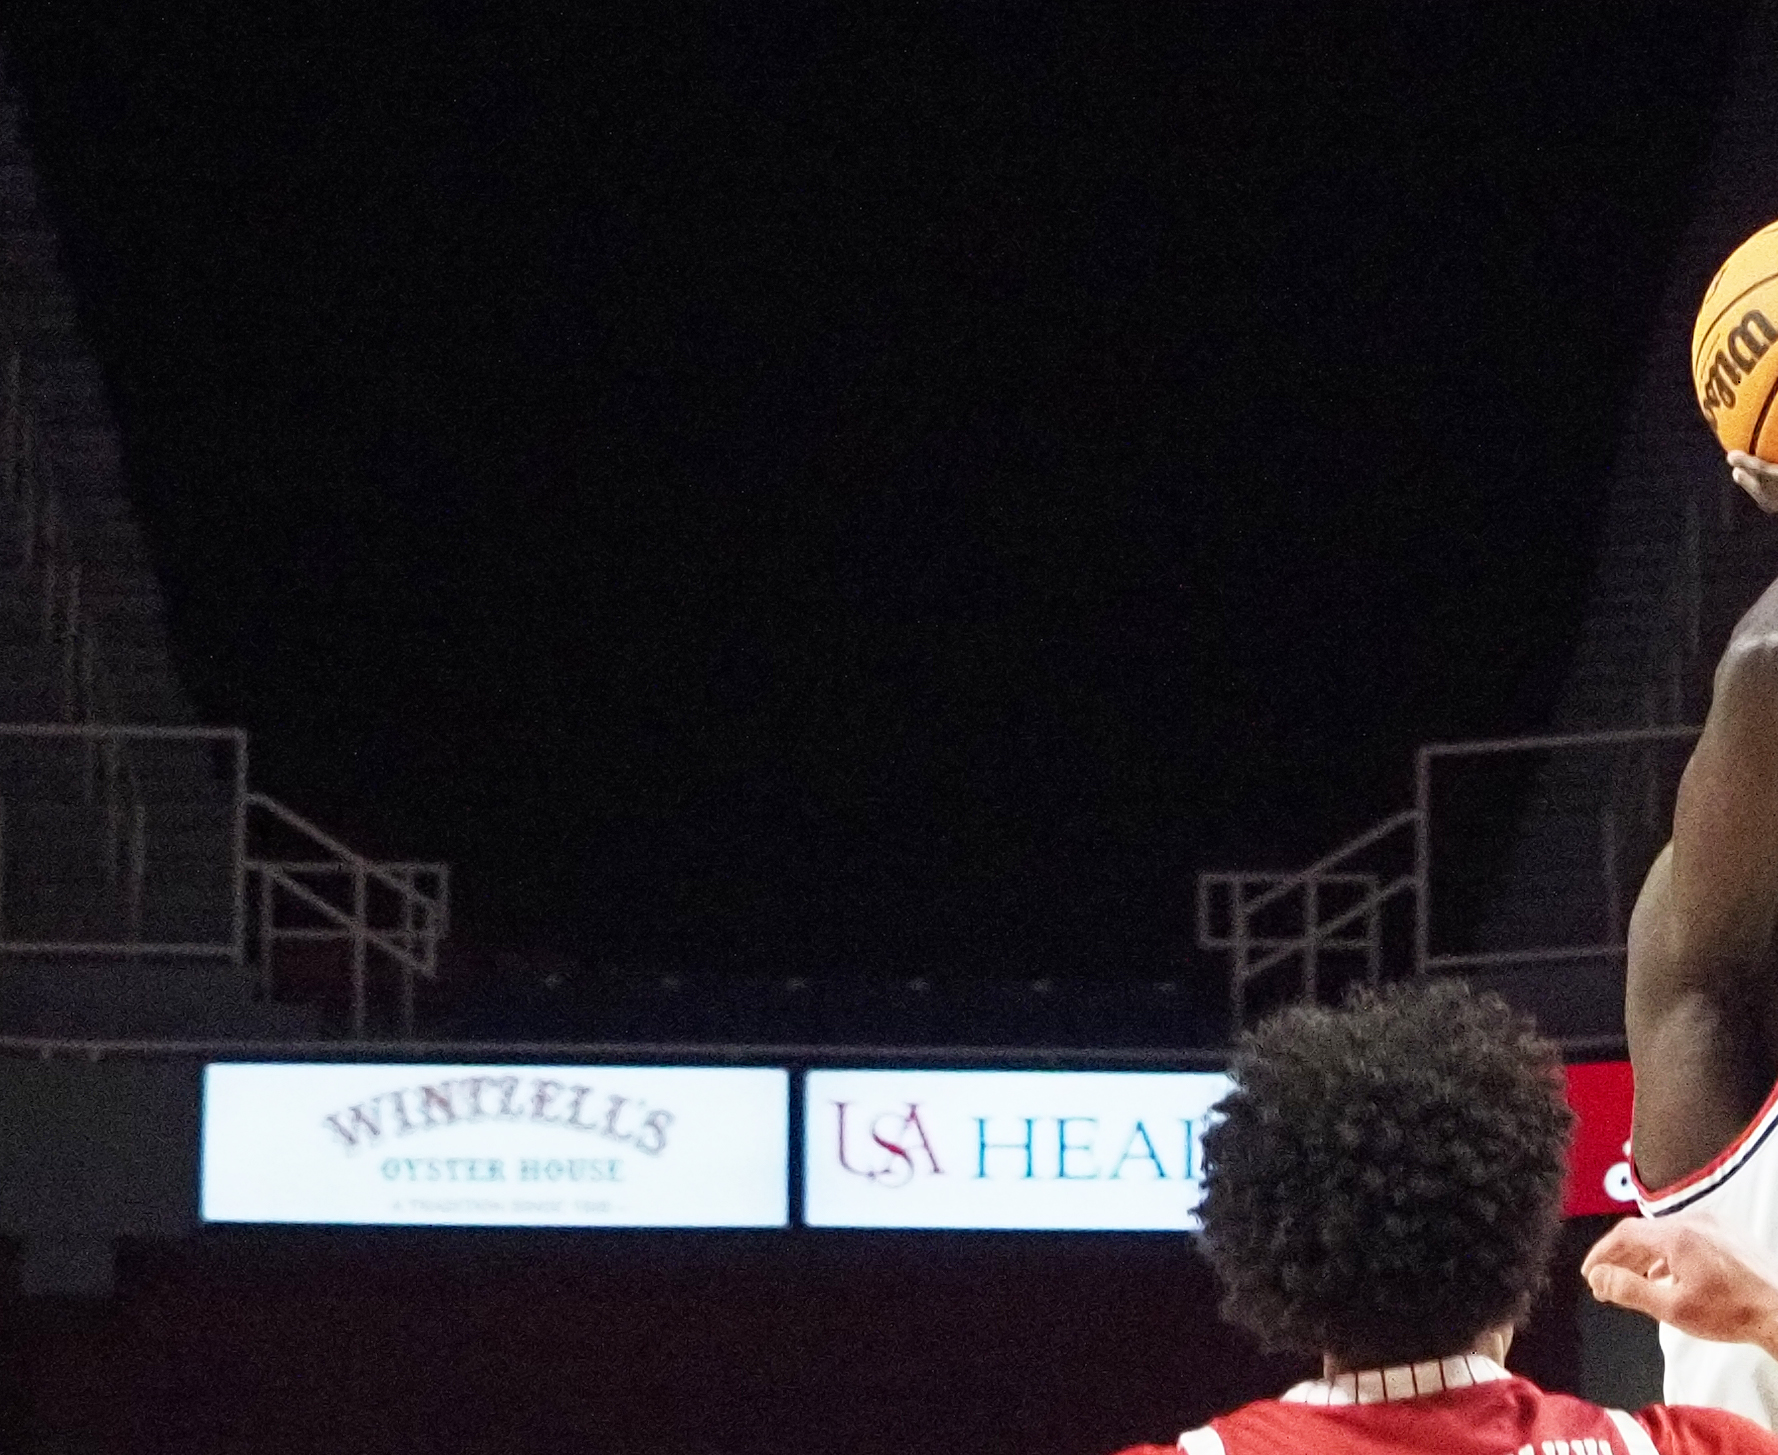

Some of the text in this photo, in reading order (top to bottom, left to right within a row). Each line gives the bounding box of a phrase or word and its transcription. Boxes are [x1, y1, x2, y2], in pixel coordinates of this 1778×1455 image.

[380, 1157, 625, 1183] OYSTER HOUSE
[829, 1101, 943, 1187] USA
